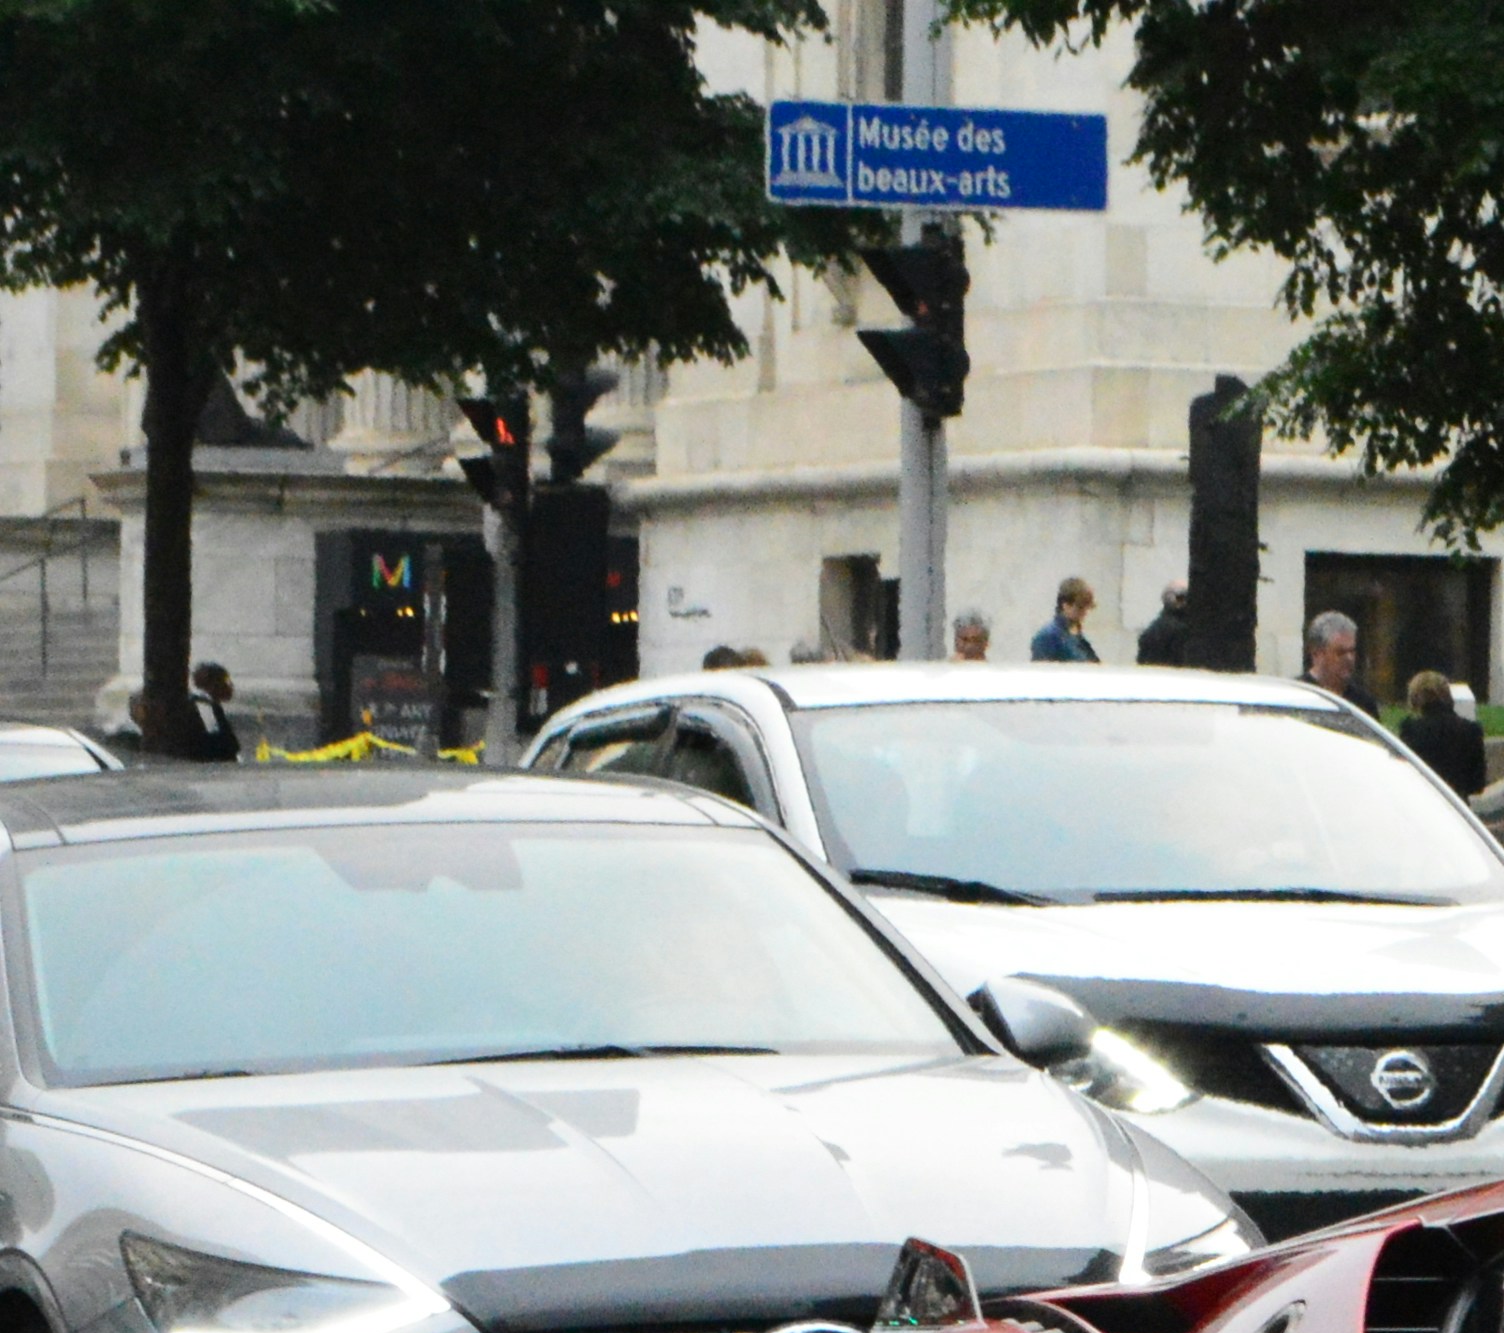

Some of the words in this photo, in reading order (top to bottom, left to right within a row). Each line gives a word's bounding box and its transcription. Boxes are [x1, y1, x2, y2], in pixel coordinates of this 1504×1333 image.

[858, 115, 949, 151] Musée
[957, 119, 1006, 155] des
[858, 160, 1011, 199] beaux-arts
[371, 552, 411, 591] M
